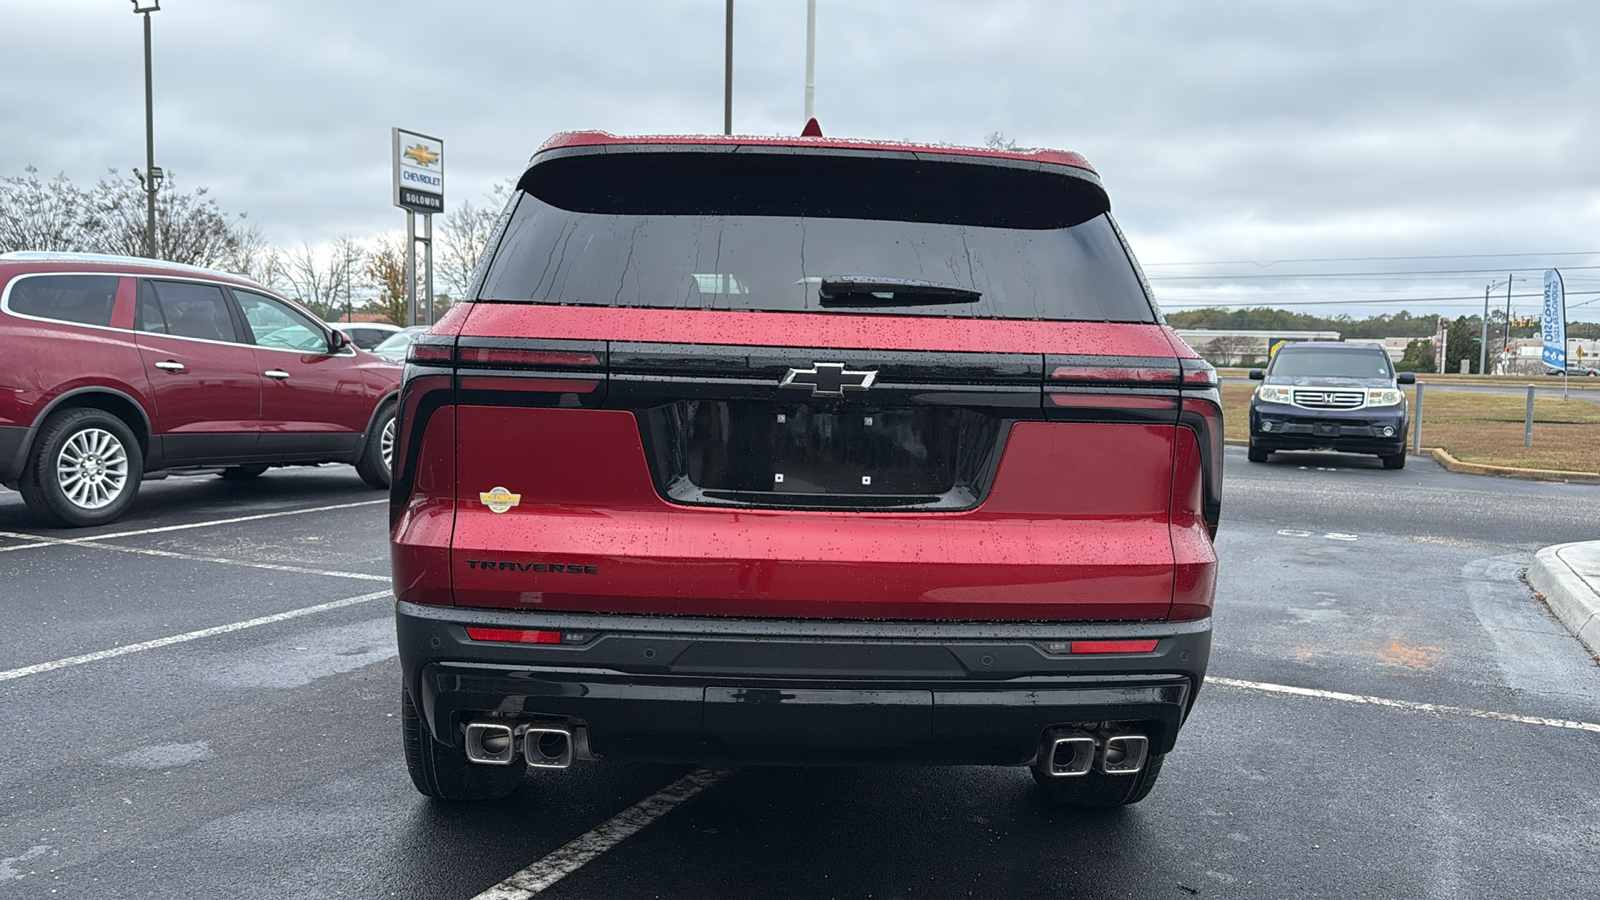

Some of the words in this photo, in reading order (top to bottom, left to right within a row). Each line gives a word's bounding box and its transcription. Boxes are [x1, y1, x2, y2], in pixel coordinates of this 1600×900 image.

[403, 171, 440, 186] CHEVROLET
[406, 193, 440, 207] SOLOMON
[466, 559, 599, 574] TRAVERSE
